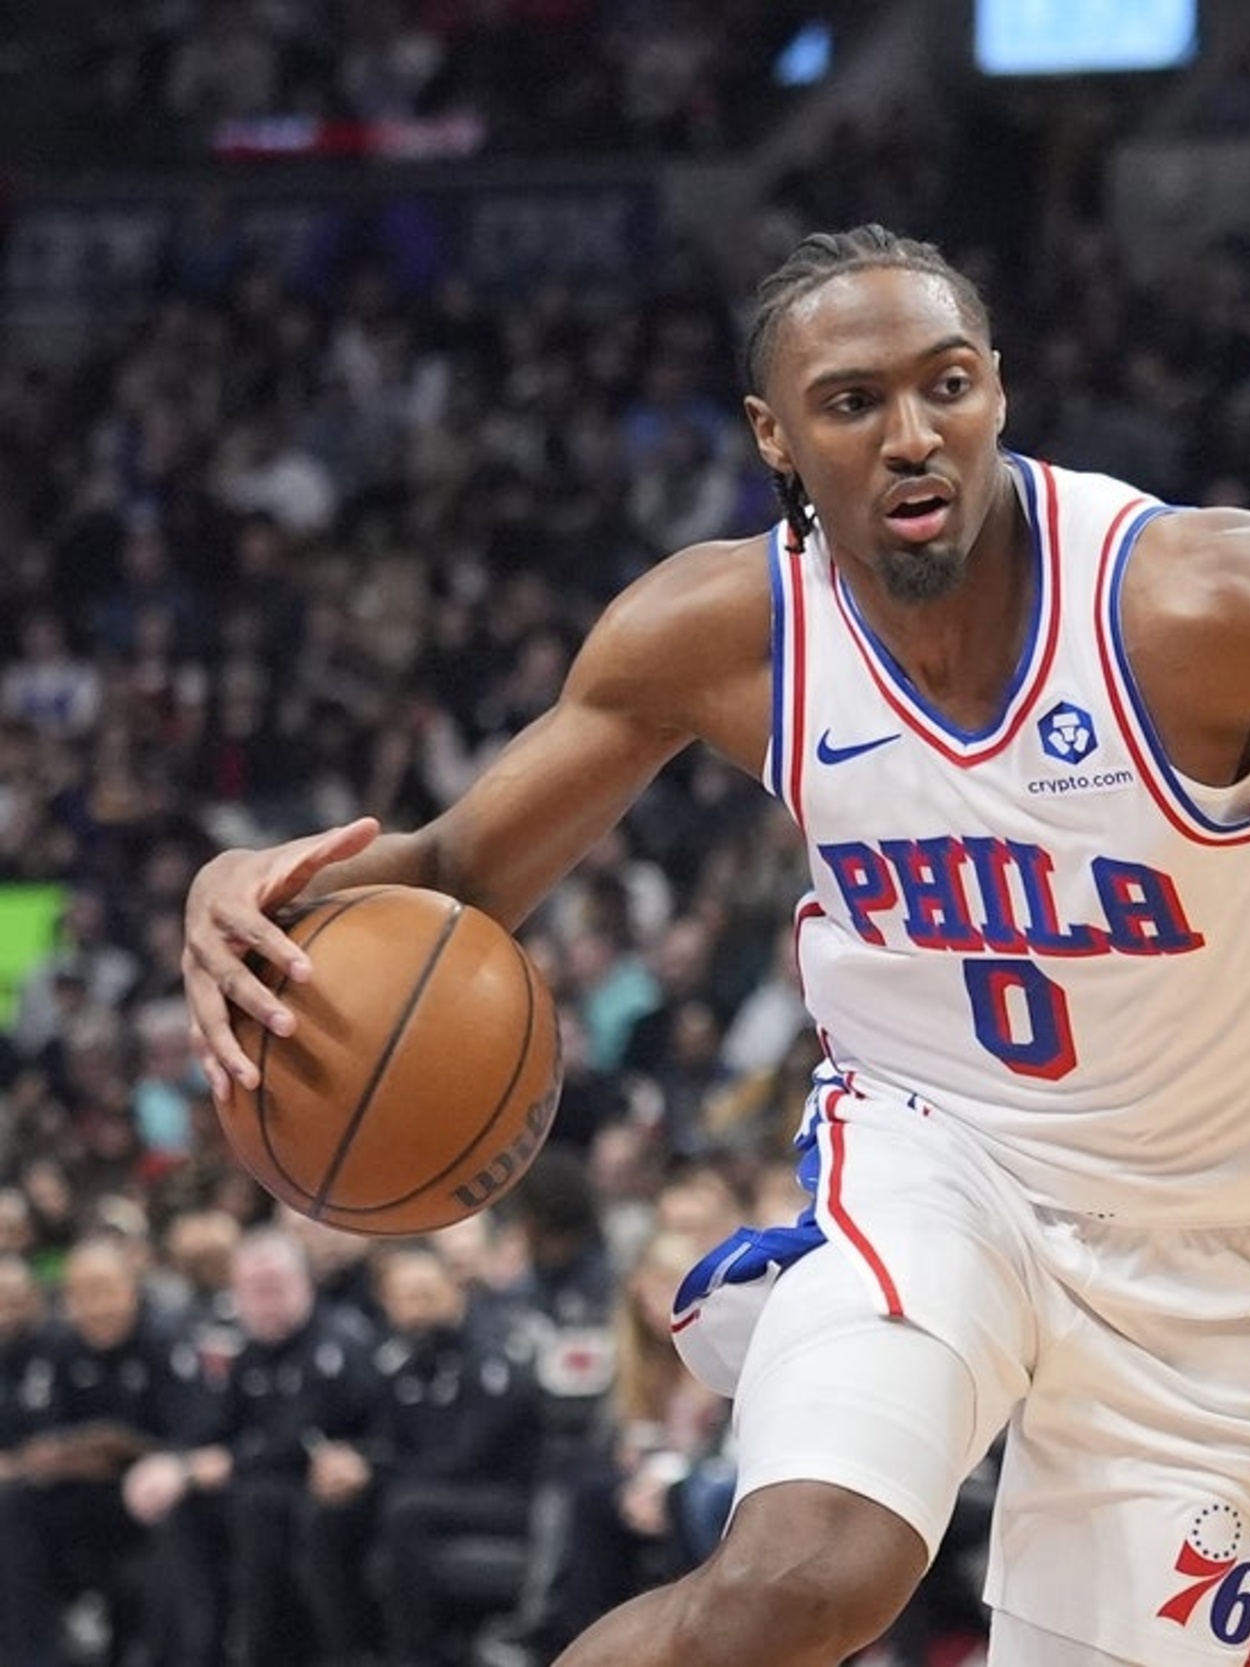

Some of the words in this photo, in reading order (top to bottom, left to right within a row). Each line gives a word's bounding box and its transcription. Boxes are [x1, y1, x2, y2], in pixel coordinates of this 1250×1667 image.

[1027, 770, 1134, 794] crypto.com
[817, 836, 1206, 958] PHILA
[962, 958, 1078, 1082] 0
